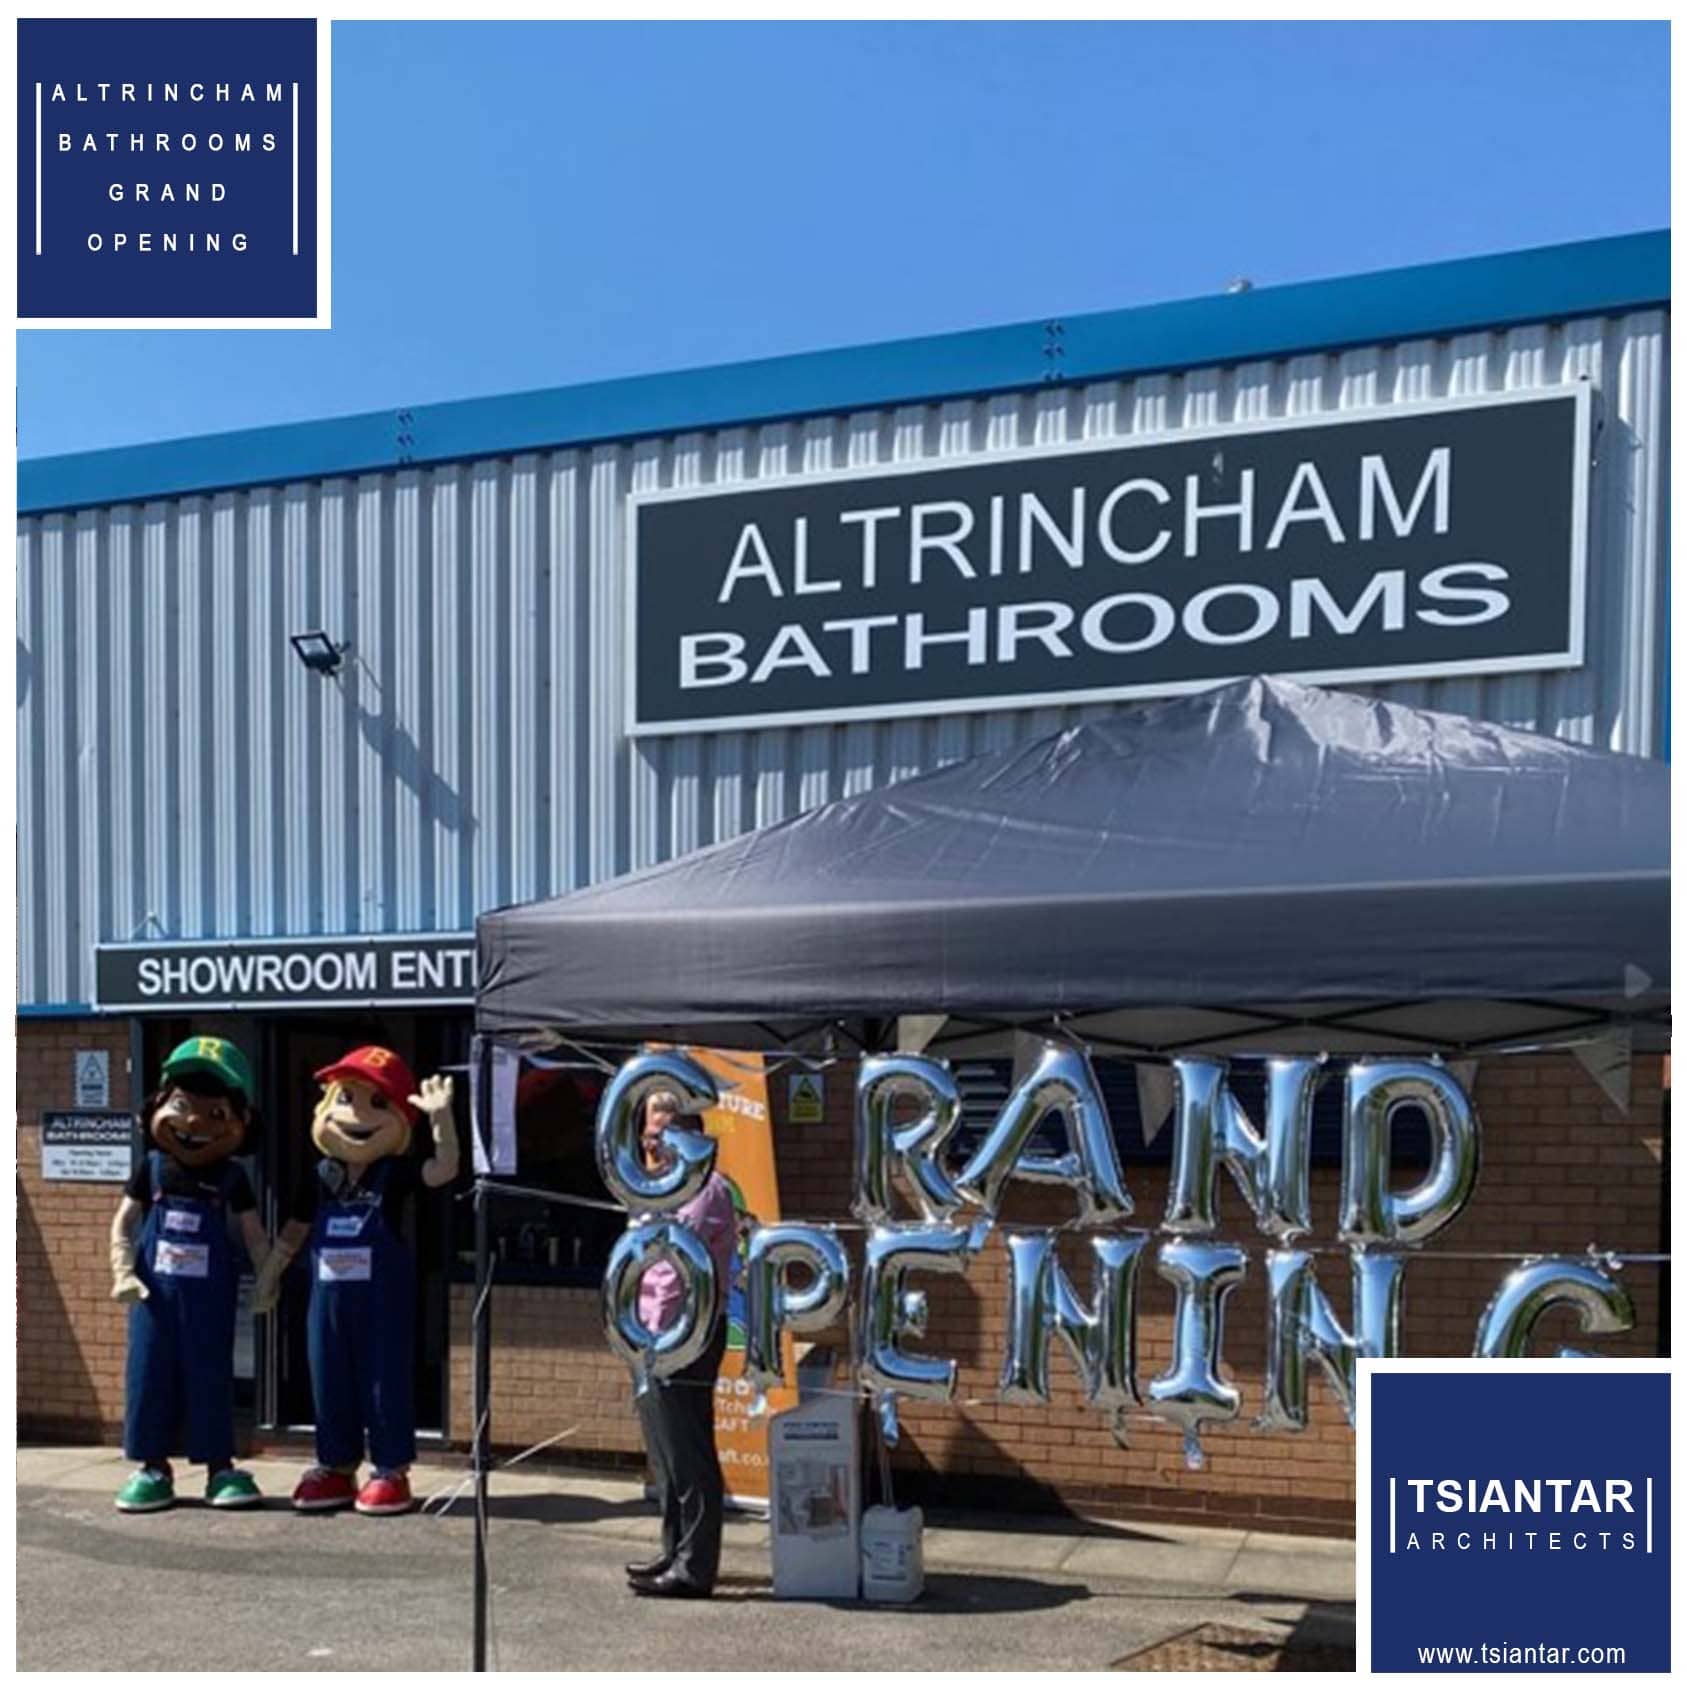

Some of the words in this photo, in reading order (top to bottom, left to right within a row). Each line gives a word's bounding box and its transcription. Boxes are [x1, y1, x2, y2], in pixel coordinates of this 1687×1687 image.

[718, 446, 1453, 604] ALTRINCHAM
[678, 561, 1511, 690] BATHROOMS
[137, 951, 377, 995] SHOWROOM
[391, 948, 476, 989] ENT
[197, 1036, 222, 1062] R
[362, 1049, 393, 1068] B
[717, 1090, 766, 1121] TURE
[595, 1042, 1482, 1248] GRAND
